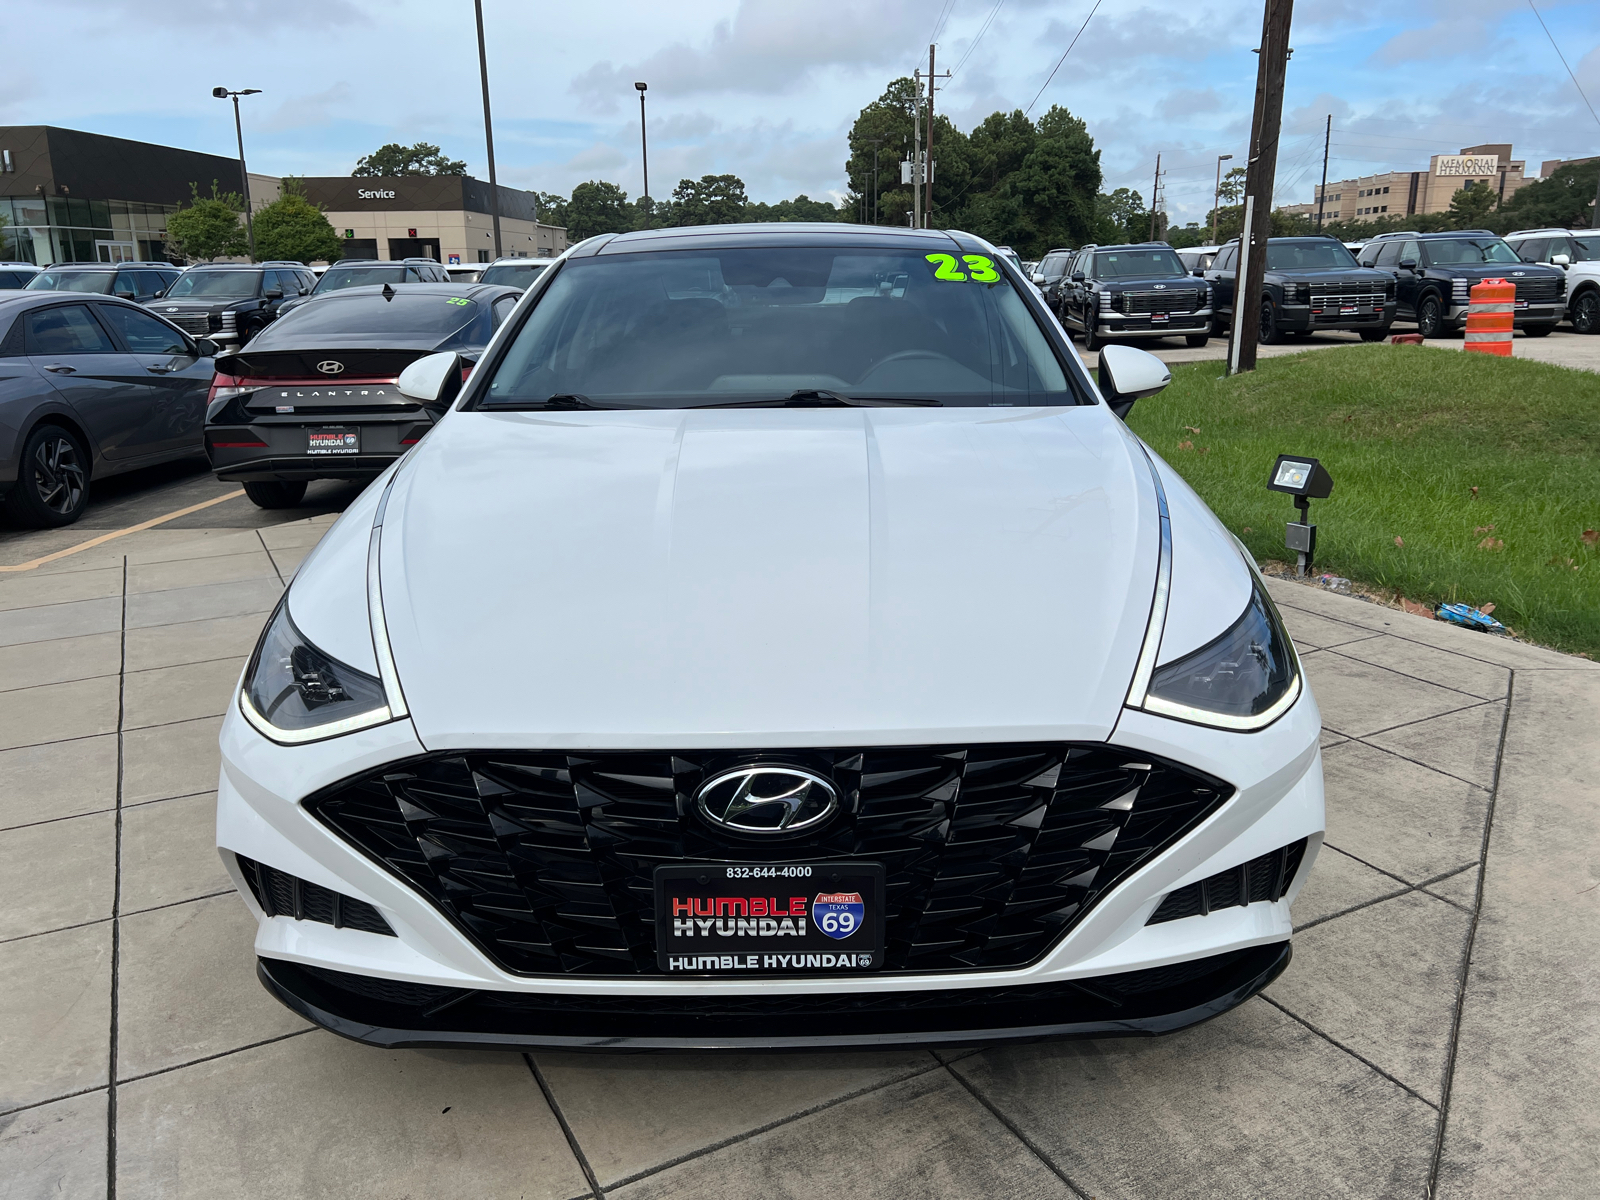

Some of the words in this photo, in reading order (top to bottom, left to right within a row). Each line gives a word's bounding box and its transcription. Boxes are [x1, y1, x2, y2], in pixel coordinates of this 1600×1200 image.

[1440, 158, 1495, 168] MEMORIAL
[1440, 166, 1494, 175] HERMANN
[358, 188, 396, 199] Service
[925, 253, 1000, 283] 23
[445, 297, 471, 306] 25
[726, 867, 812, 878] 832-644-4000
[821, 895, 856, 903] INTERSTATE
[672, 897, 808, 917] HUMBLE
[673, 918, 807, 937] HYUNDAI
[822, 912, 855, 933] 69
[669, 956, 759, 971] HUMBLE
[763, 954, 857, 968] HYUNDAI
